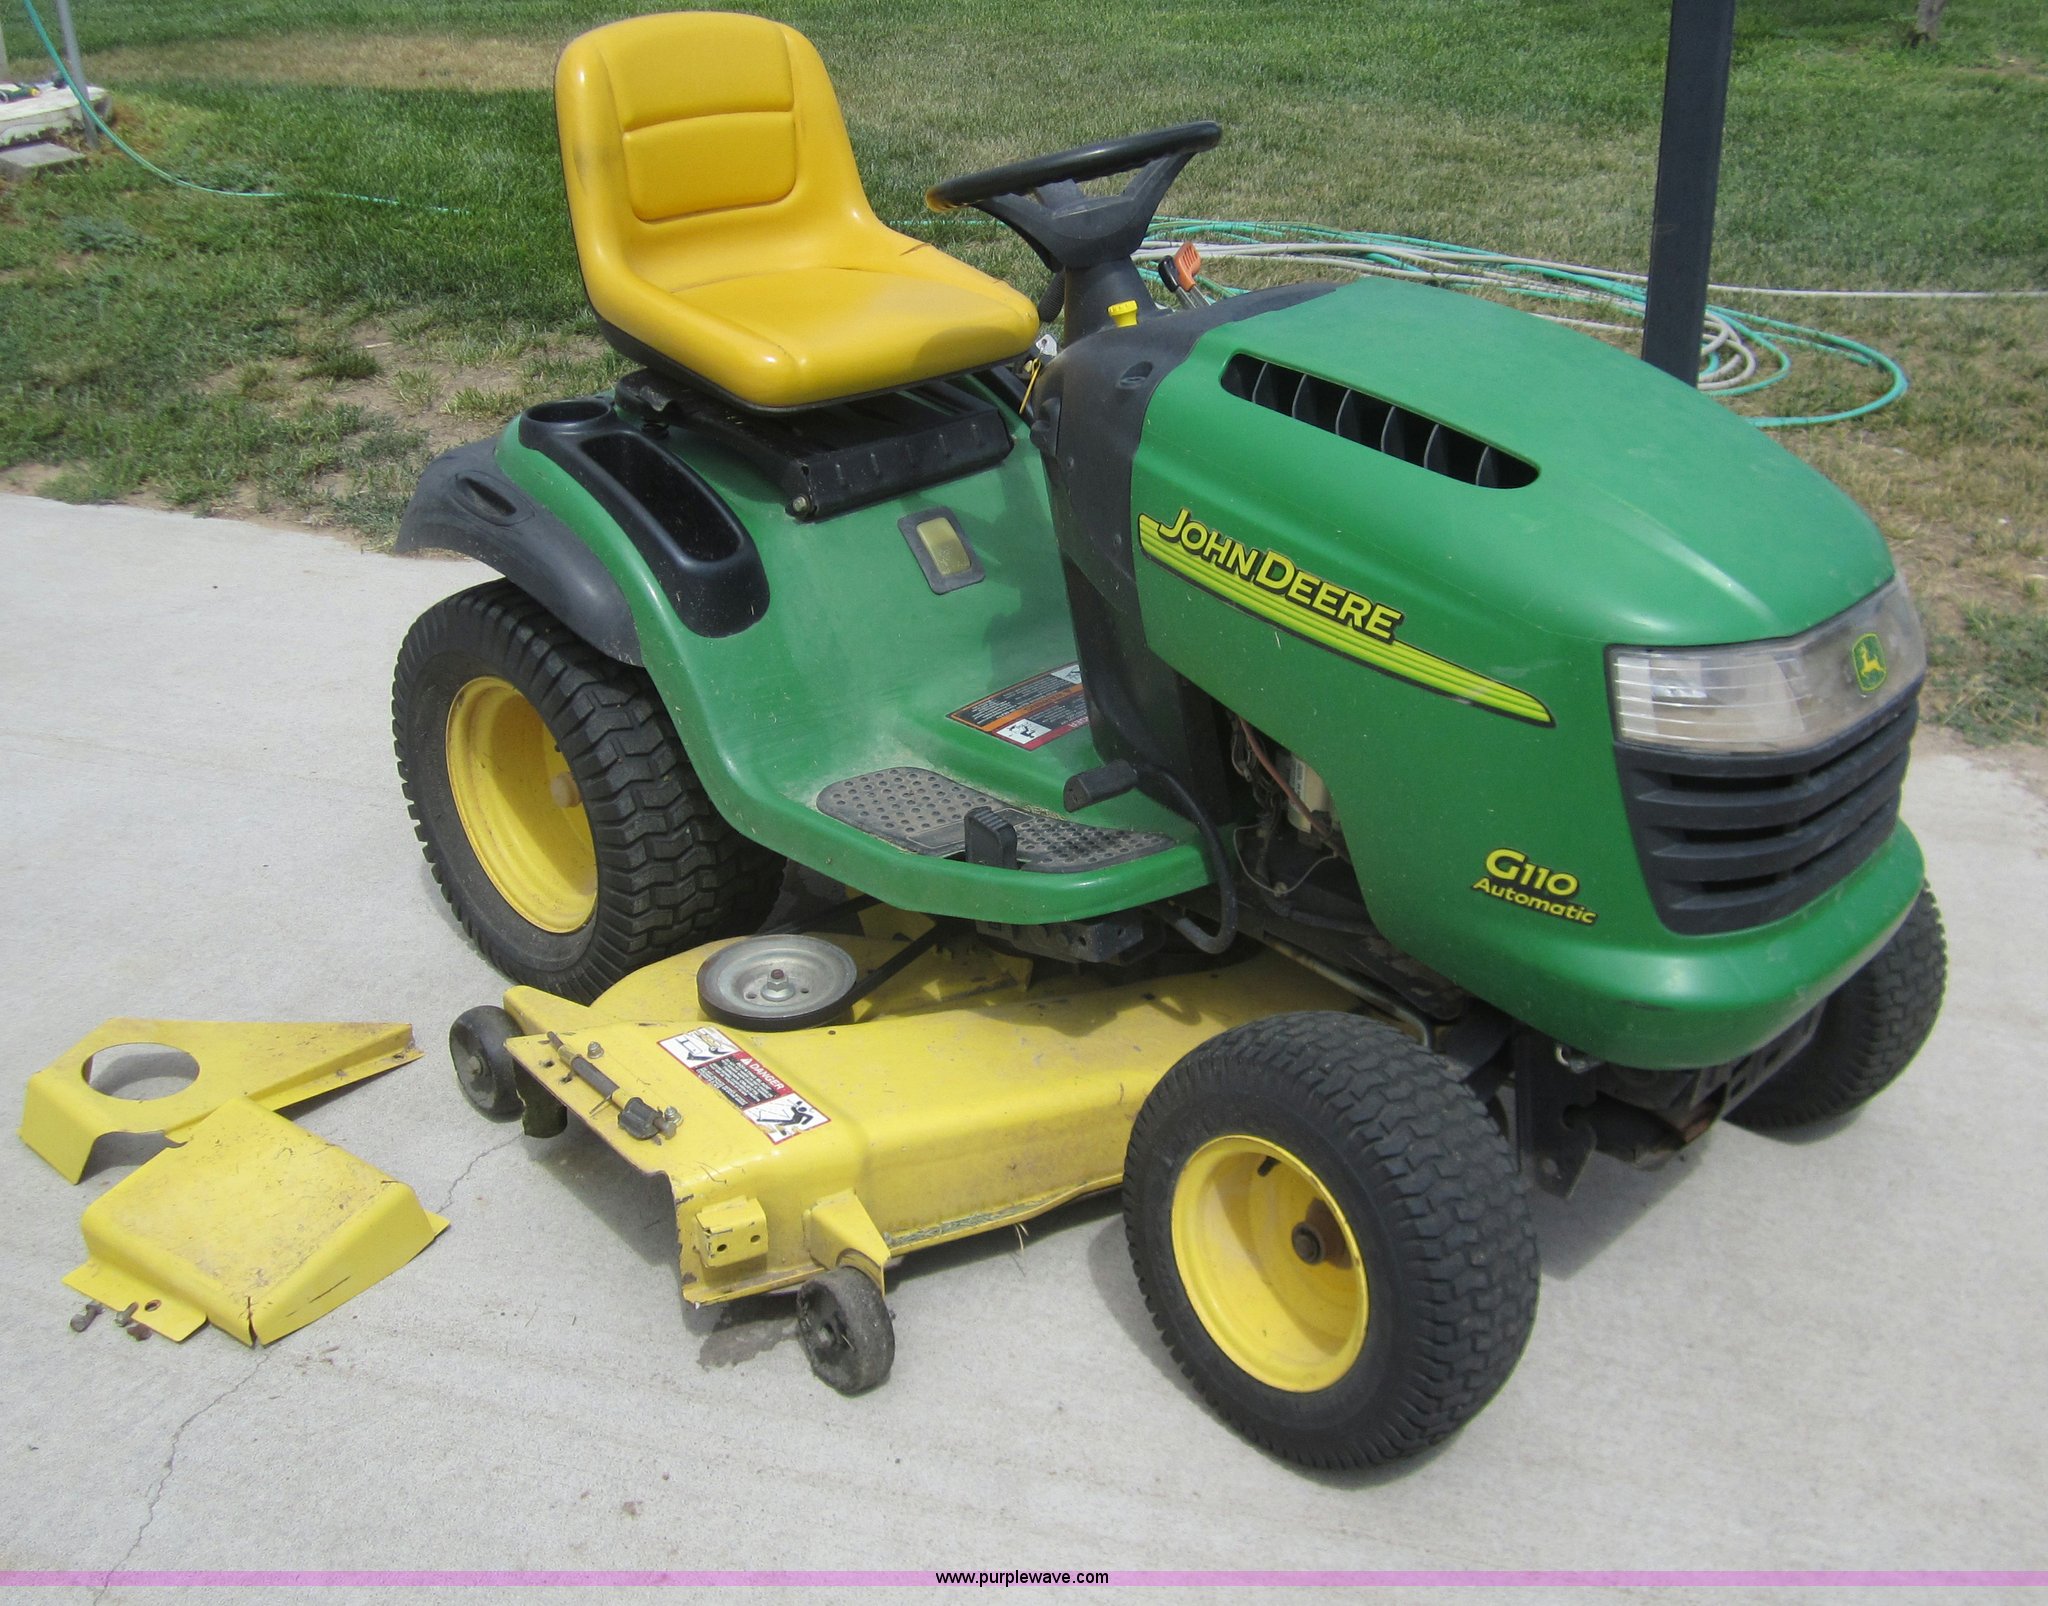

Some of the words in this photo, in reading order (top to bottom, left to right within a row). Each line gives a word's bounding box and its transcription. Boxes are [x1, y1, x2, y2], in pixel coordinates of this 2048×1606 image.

[1158, 508, 1259, 577] JOHN
[1254, 550, 1403, 640] DEERE
[1485, 848, 1579, 897] G110
[1472, 877, 1597, 924] Automatic
[749, 1063, 785, 1090] DANGER
